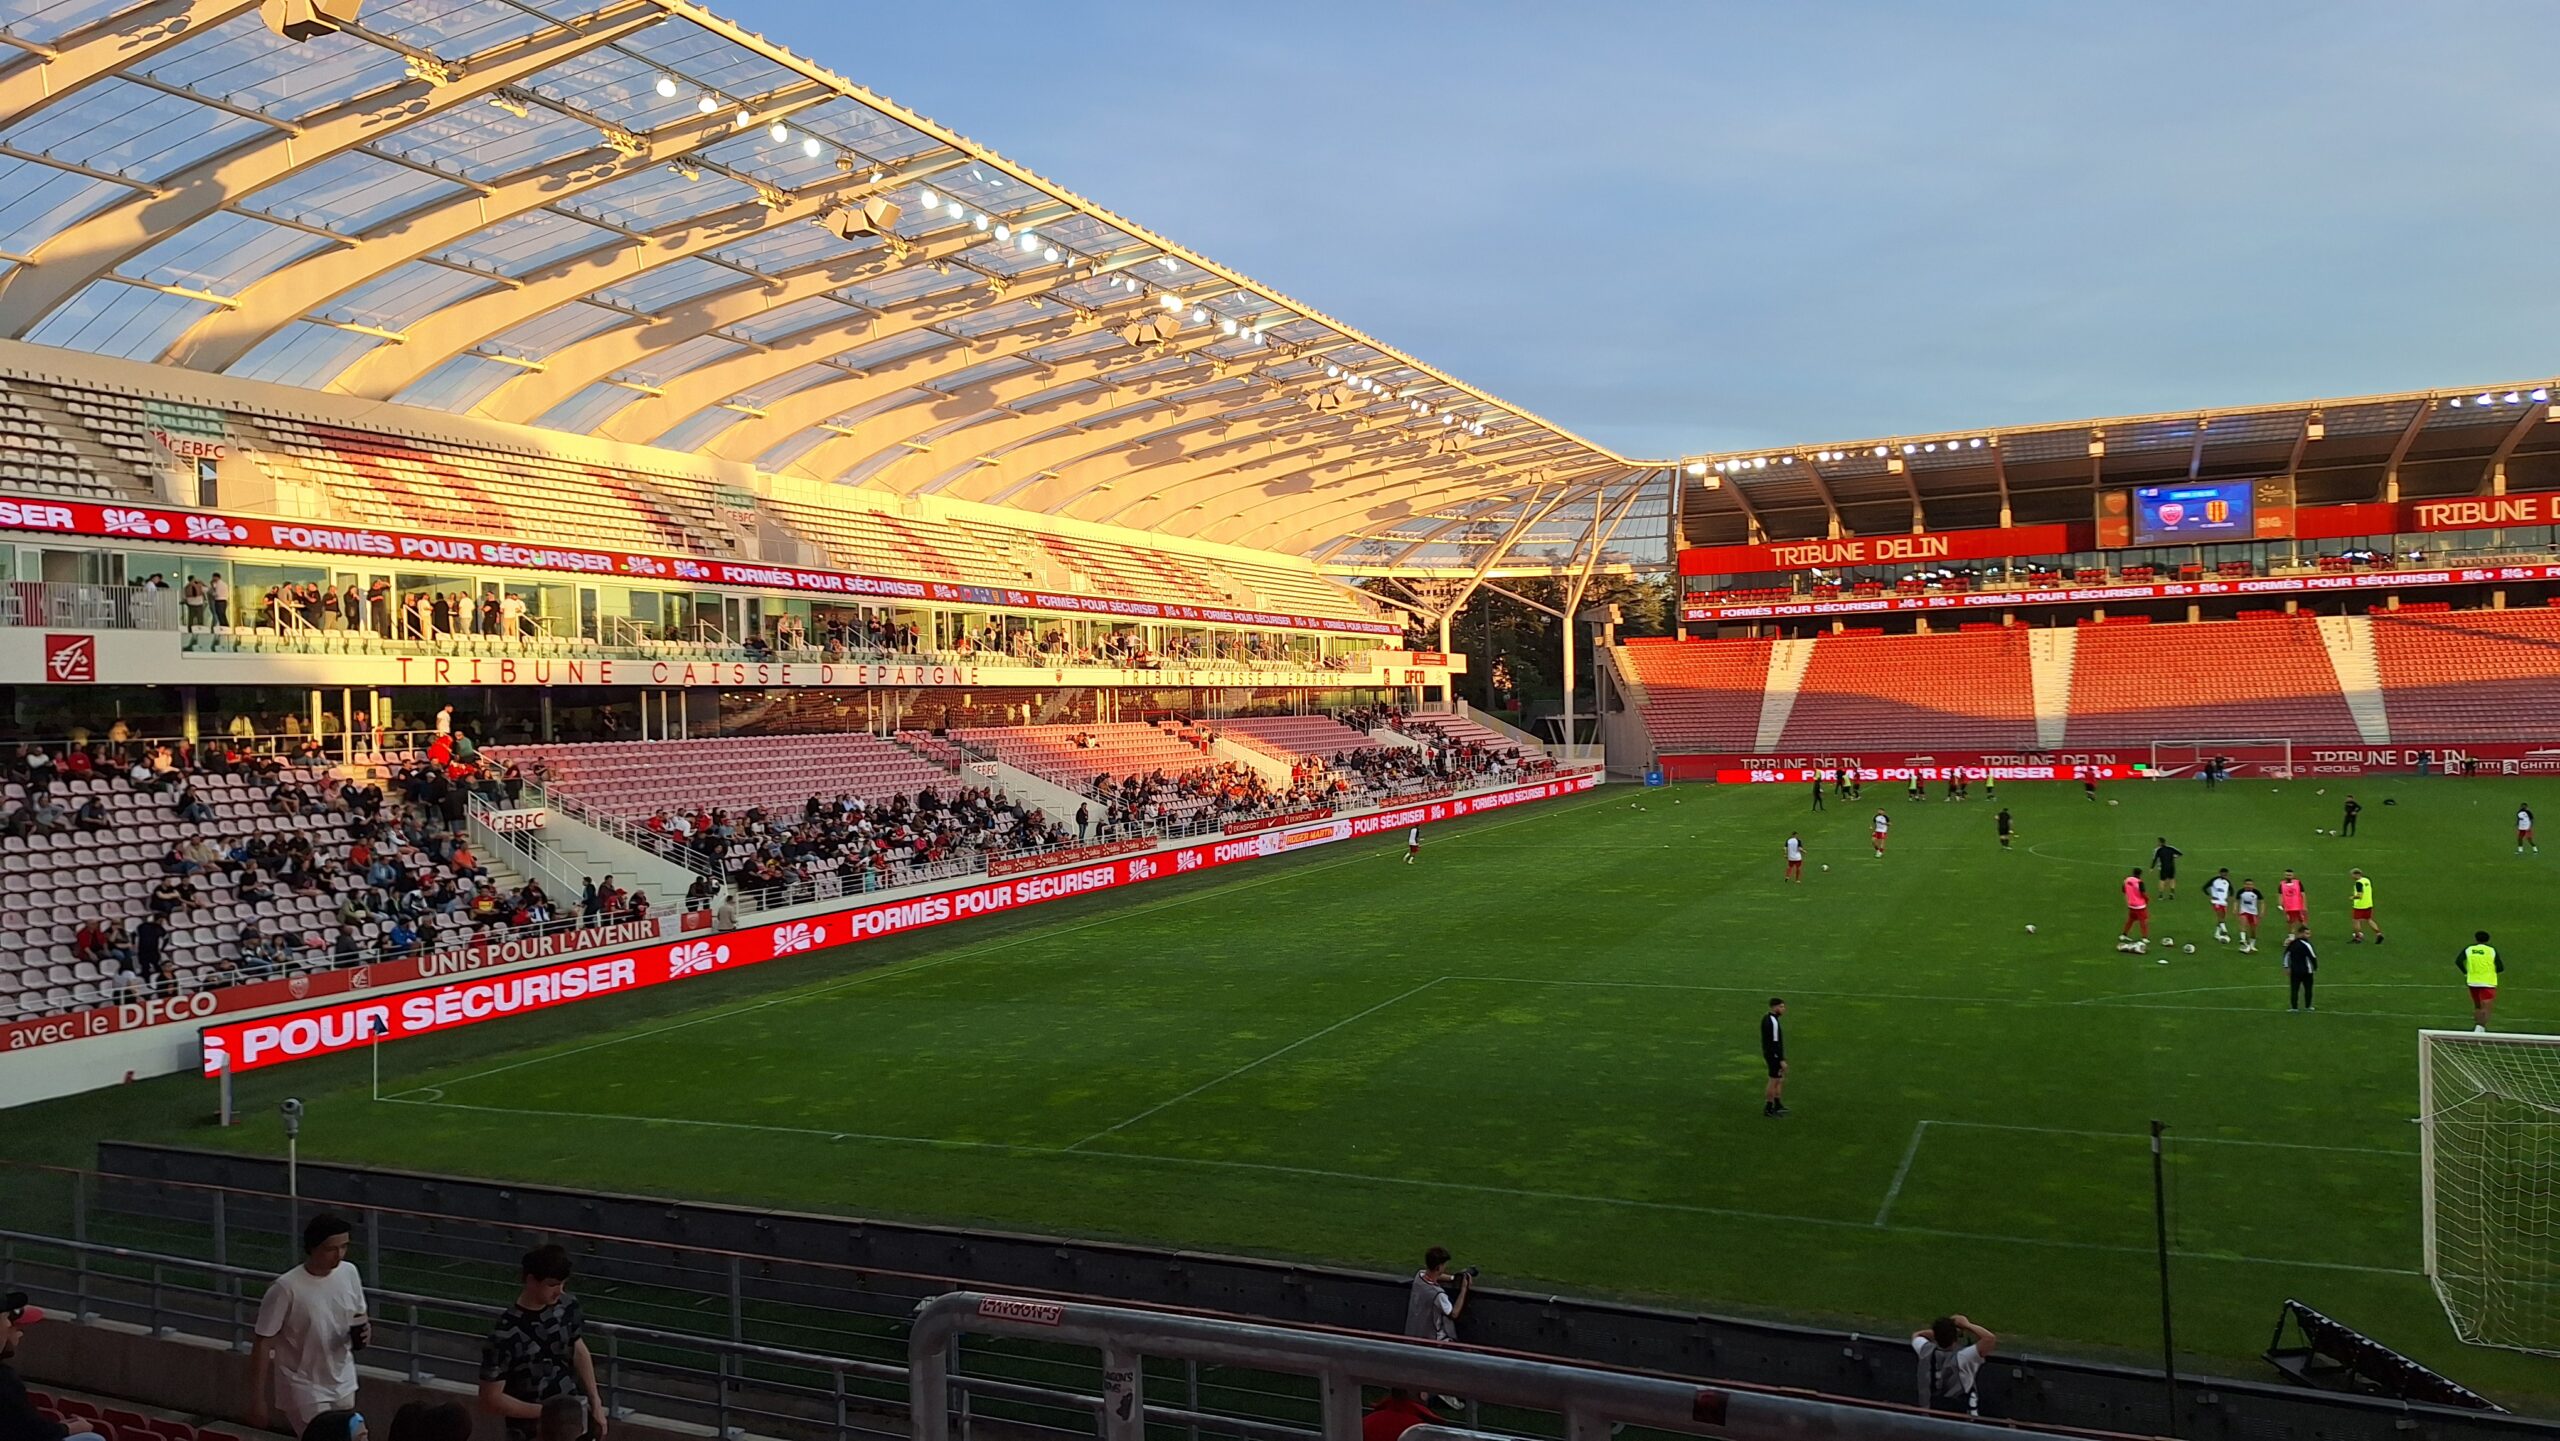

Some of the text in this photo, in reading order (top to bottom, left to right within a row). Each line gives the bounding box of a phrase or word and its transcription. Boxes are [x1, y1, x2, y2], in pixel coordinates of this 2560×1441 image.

[169, 439, 226, 459] CEBFC
[102, 508, 230, 541] SIG SIG
[2414, 498, 2538, 527] TRIBUNE
[271, 523, 612, 572] FORMÉS POUR SÉCURISER
[1770, 536, 1949, 566] TRIBUNE DELIN
[721, 566, 926, 597] FORMÉS POUR SÉCURISER
[2239, 573, 2449, 592] FORMÉS POUR SÉCURISER
[1036, 594, 1160, 615] FORMÉS POUR SÉCURISER
[1720, 601, 1889, 617] FORMÉS POUR SÉCURISER
[1964, 587, 2153, 605] FORMÉS POUR SÉCURISER
[1202, 607, 1291, 625] FORMÉS POUR SÉCURISER
[396, 657, 613, 684] TRIBUNE
[652, 662, 792, 685] CAISSE
[1121, 669, 1195, 685] TRIBUNE
[1207, 671, 1262, 686] CAISSE
[1404, 669, 1425, 684] DFCO
[2312, 750, 2397, 766] TRIBUNE
[1941, 767, 2054, 780] SCURISER
[1472, 792, 1498, 811] FORMÉS
[1498, 791, 1514, 807] POUR
[1514, 786, 1546, 804] SÉCURISER
[491, 811, 544, 833] CEBFC
[1309, 827, 1334, 841] MARTIN
[1354, 816, 1379, 835] POUR
[1380, 807, 1425, 829] SÉCURISER
[1129, 850, 1196, 882] SIG SIG
[852, 866, 1115, 938] FORMÉS POUR SÉCURISER
[417, 948, 480, 977] UNIS
[487, 934, 554, 965] POUR
[559, 920, 653, 958] L'AVENIR
[669, 923, 811, 979] SIG SIG
[10, 991, 217, 1049] avec le DFCO
[242, 1005, 389, 1063] POUR
[402, 958, 636, 1031] SÉCURISER
